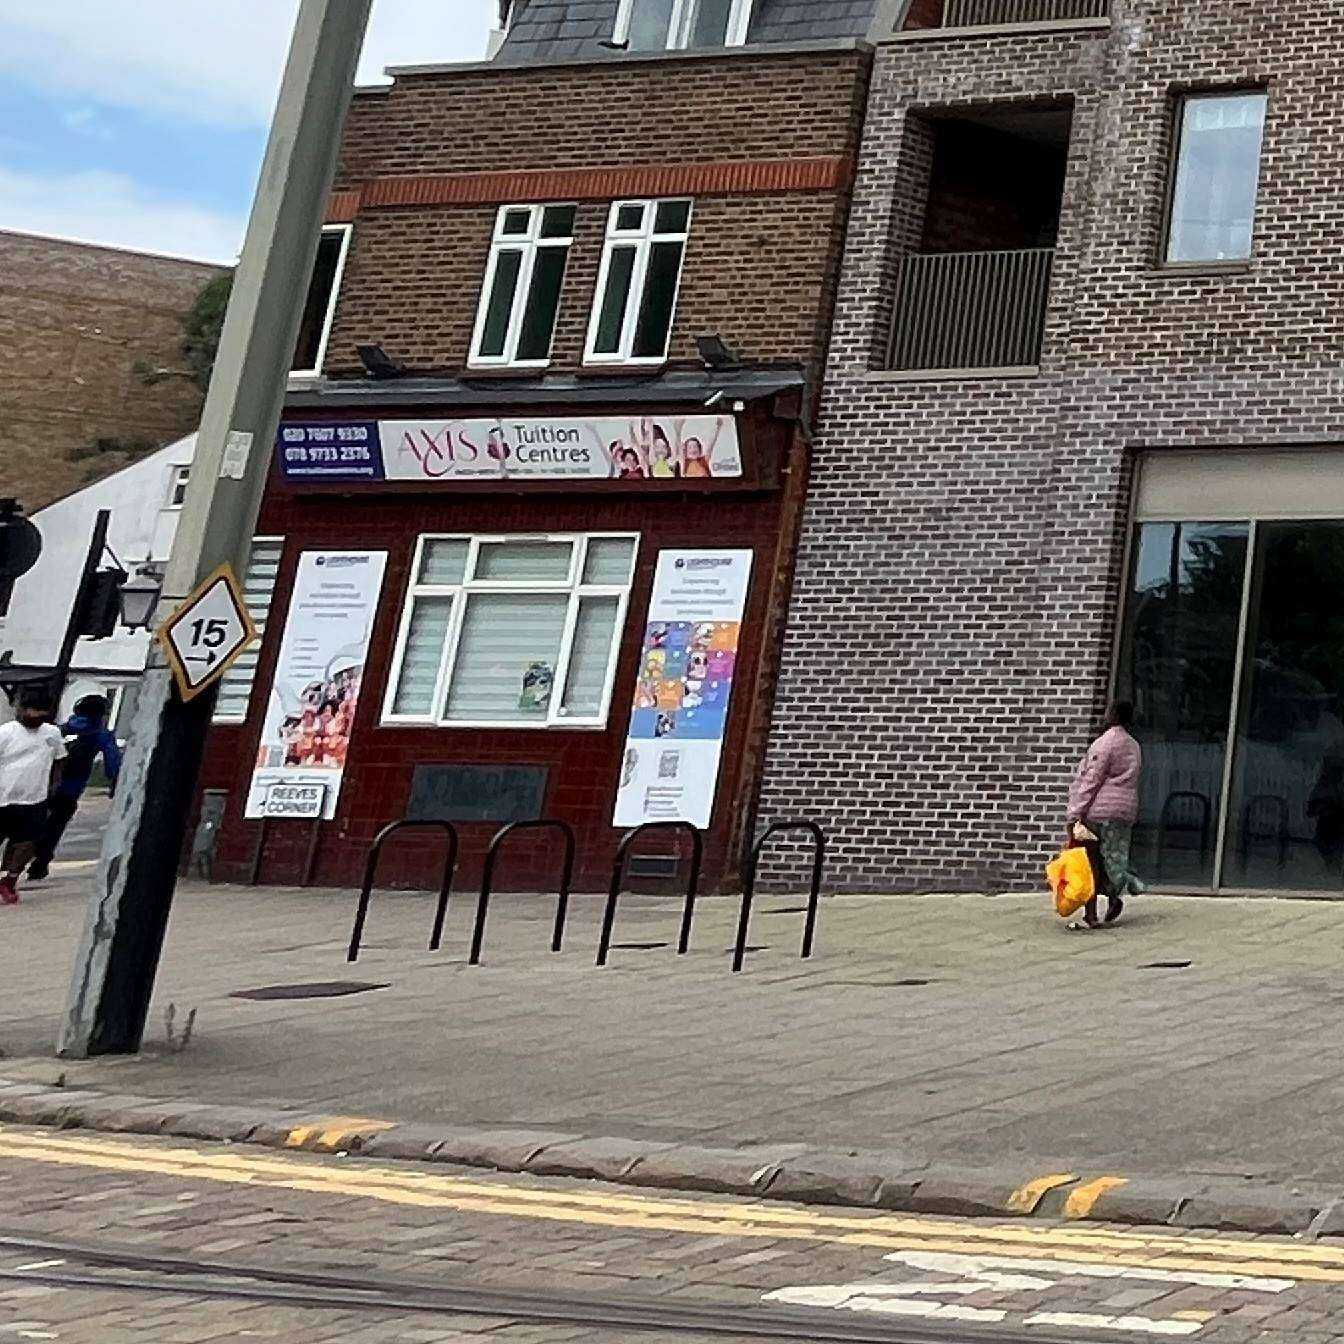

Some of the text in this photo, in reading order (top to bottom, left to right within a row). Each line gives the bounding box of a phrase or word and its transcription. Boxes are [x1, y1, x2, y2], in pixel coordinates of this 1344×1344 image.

[514, 425, 579, 444] Tuition
[515, 444, 590, 463] Centres
[191, 618, 229, 647] 15
